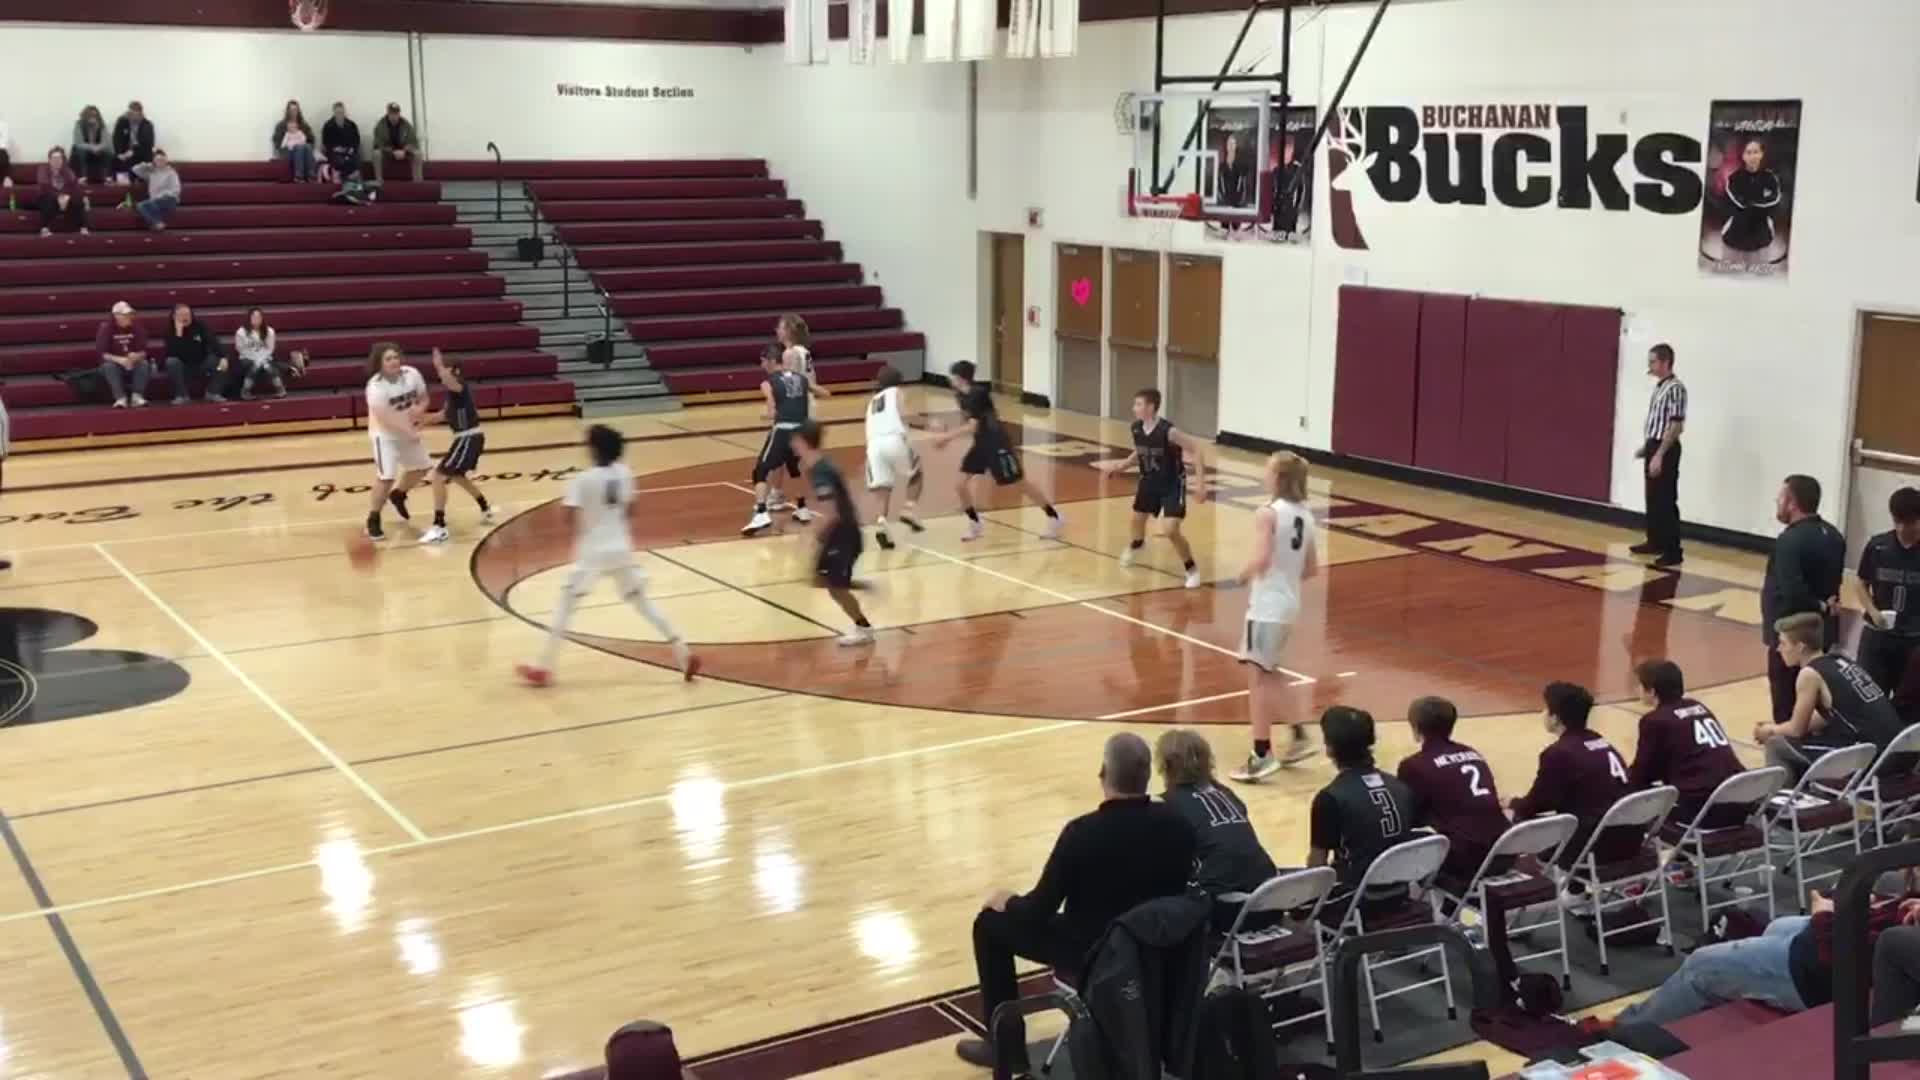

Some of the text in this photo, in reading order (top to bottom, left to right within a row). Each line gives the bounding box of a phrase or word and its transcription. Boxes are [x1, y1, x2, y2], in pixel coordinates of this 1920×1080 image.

[556, 83, 695, 98] Visitors Student Section
[1422, 104, 1552, 129] BUCHANAN
[1363, 105, 1703, 215] Bucks
[1291, 516, 1304, 551] 3
[1694, 718, 1729, 748] 40
[1460, 764, 1491, 798] 2
[1608, 751, 1629, 784] 4
[1192, 790, 1248, 828] 11
[1369, 788, 1402, 838] 3
